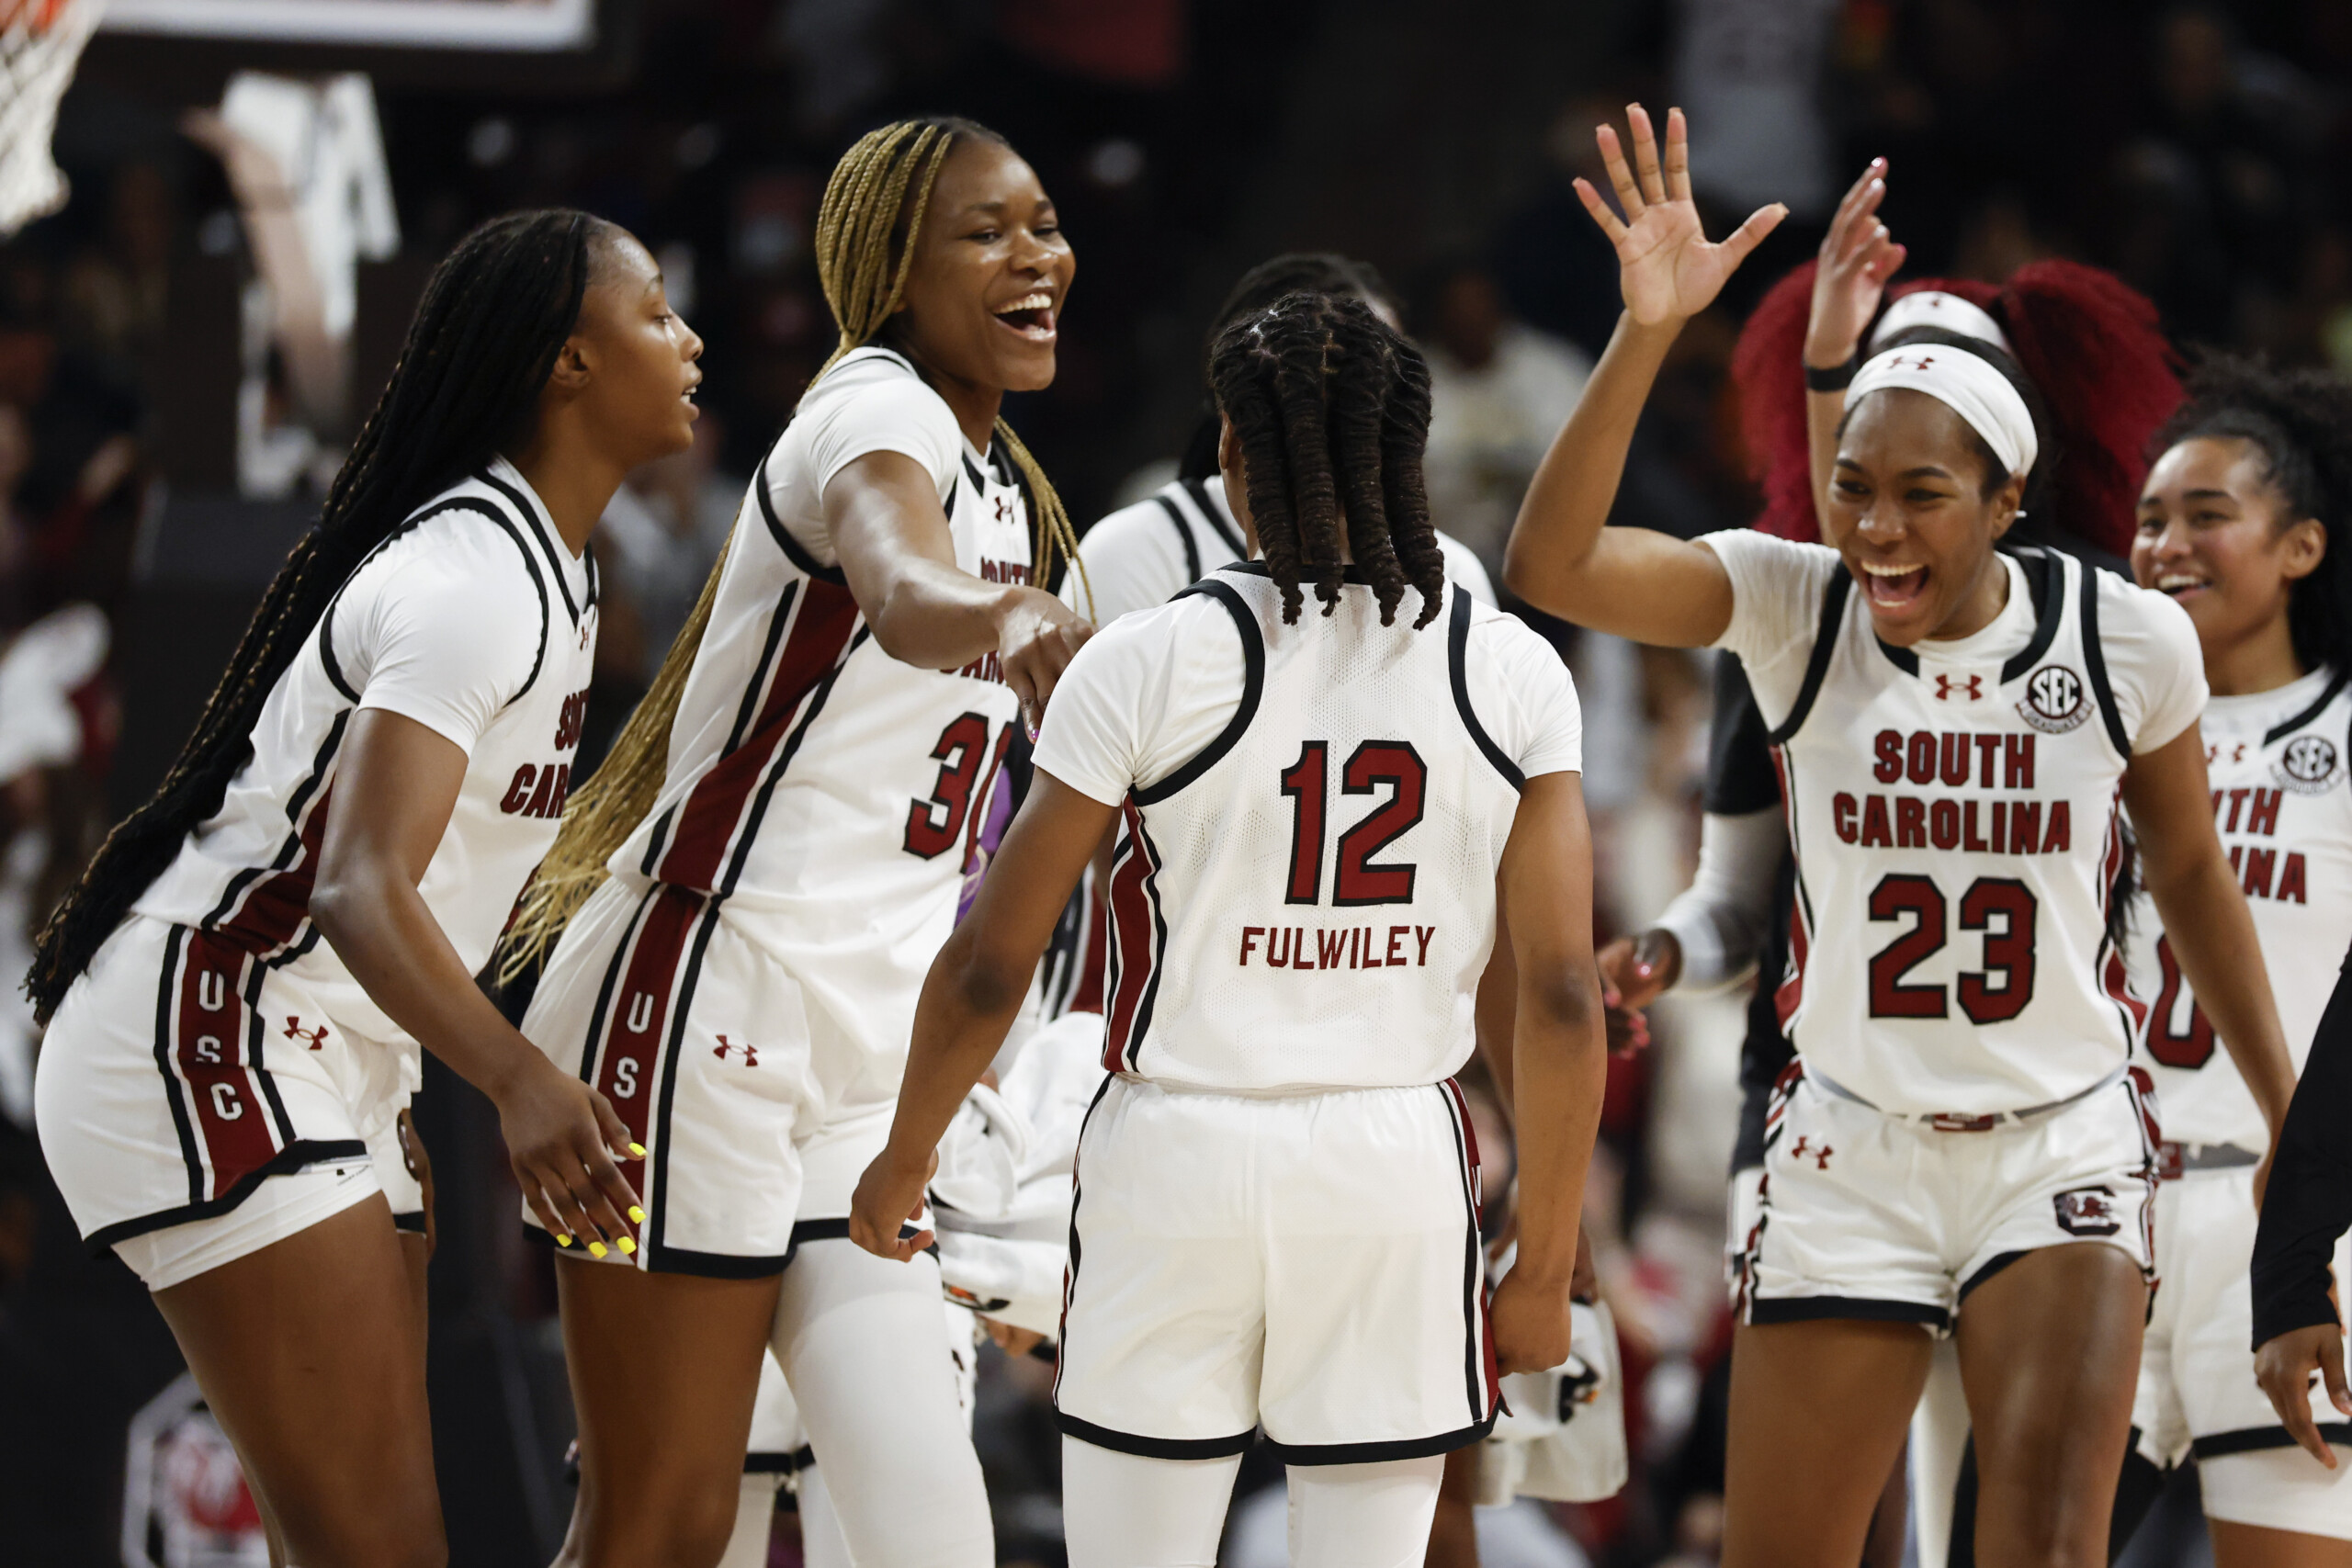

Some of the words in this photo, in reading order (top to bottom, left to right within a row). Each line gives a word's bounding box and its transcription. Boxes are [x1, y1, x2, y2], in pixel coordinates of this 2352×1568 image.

[2030, 667, 2079, 716] SEC
[1873, 729, 2036, 789] SOUTH
[2288, 738, 2335, 780] SEC
[1281, 739, 1428, 907] 12
[1833, 791, 2071, 855] CAROLINA
[1239, 924, 1436, 970] FULWILEY
[1868, 873, 2038, 1026] 23
